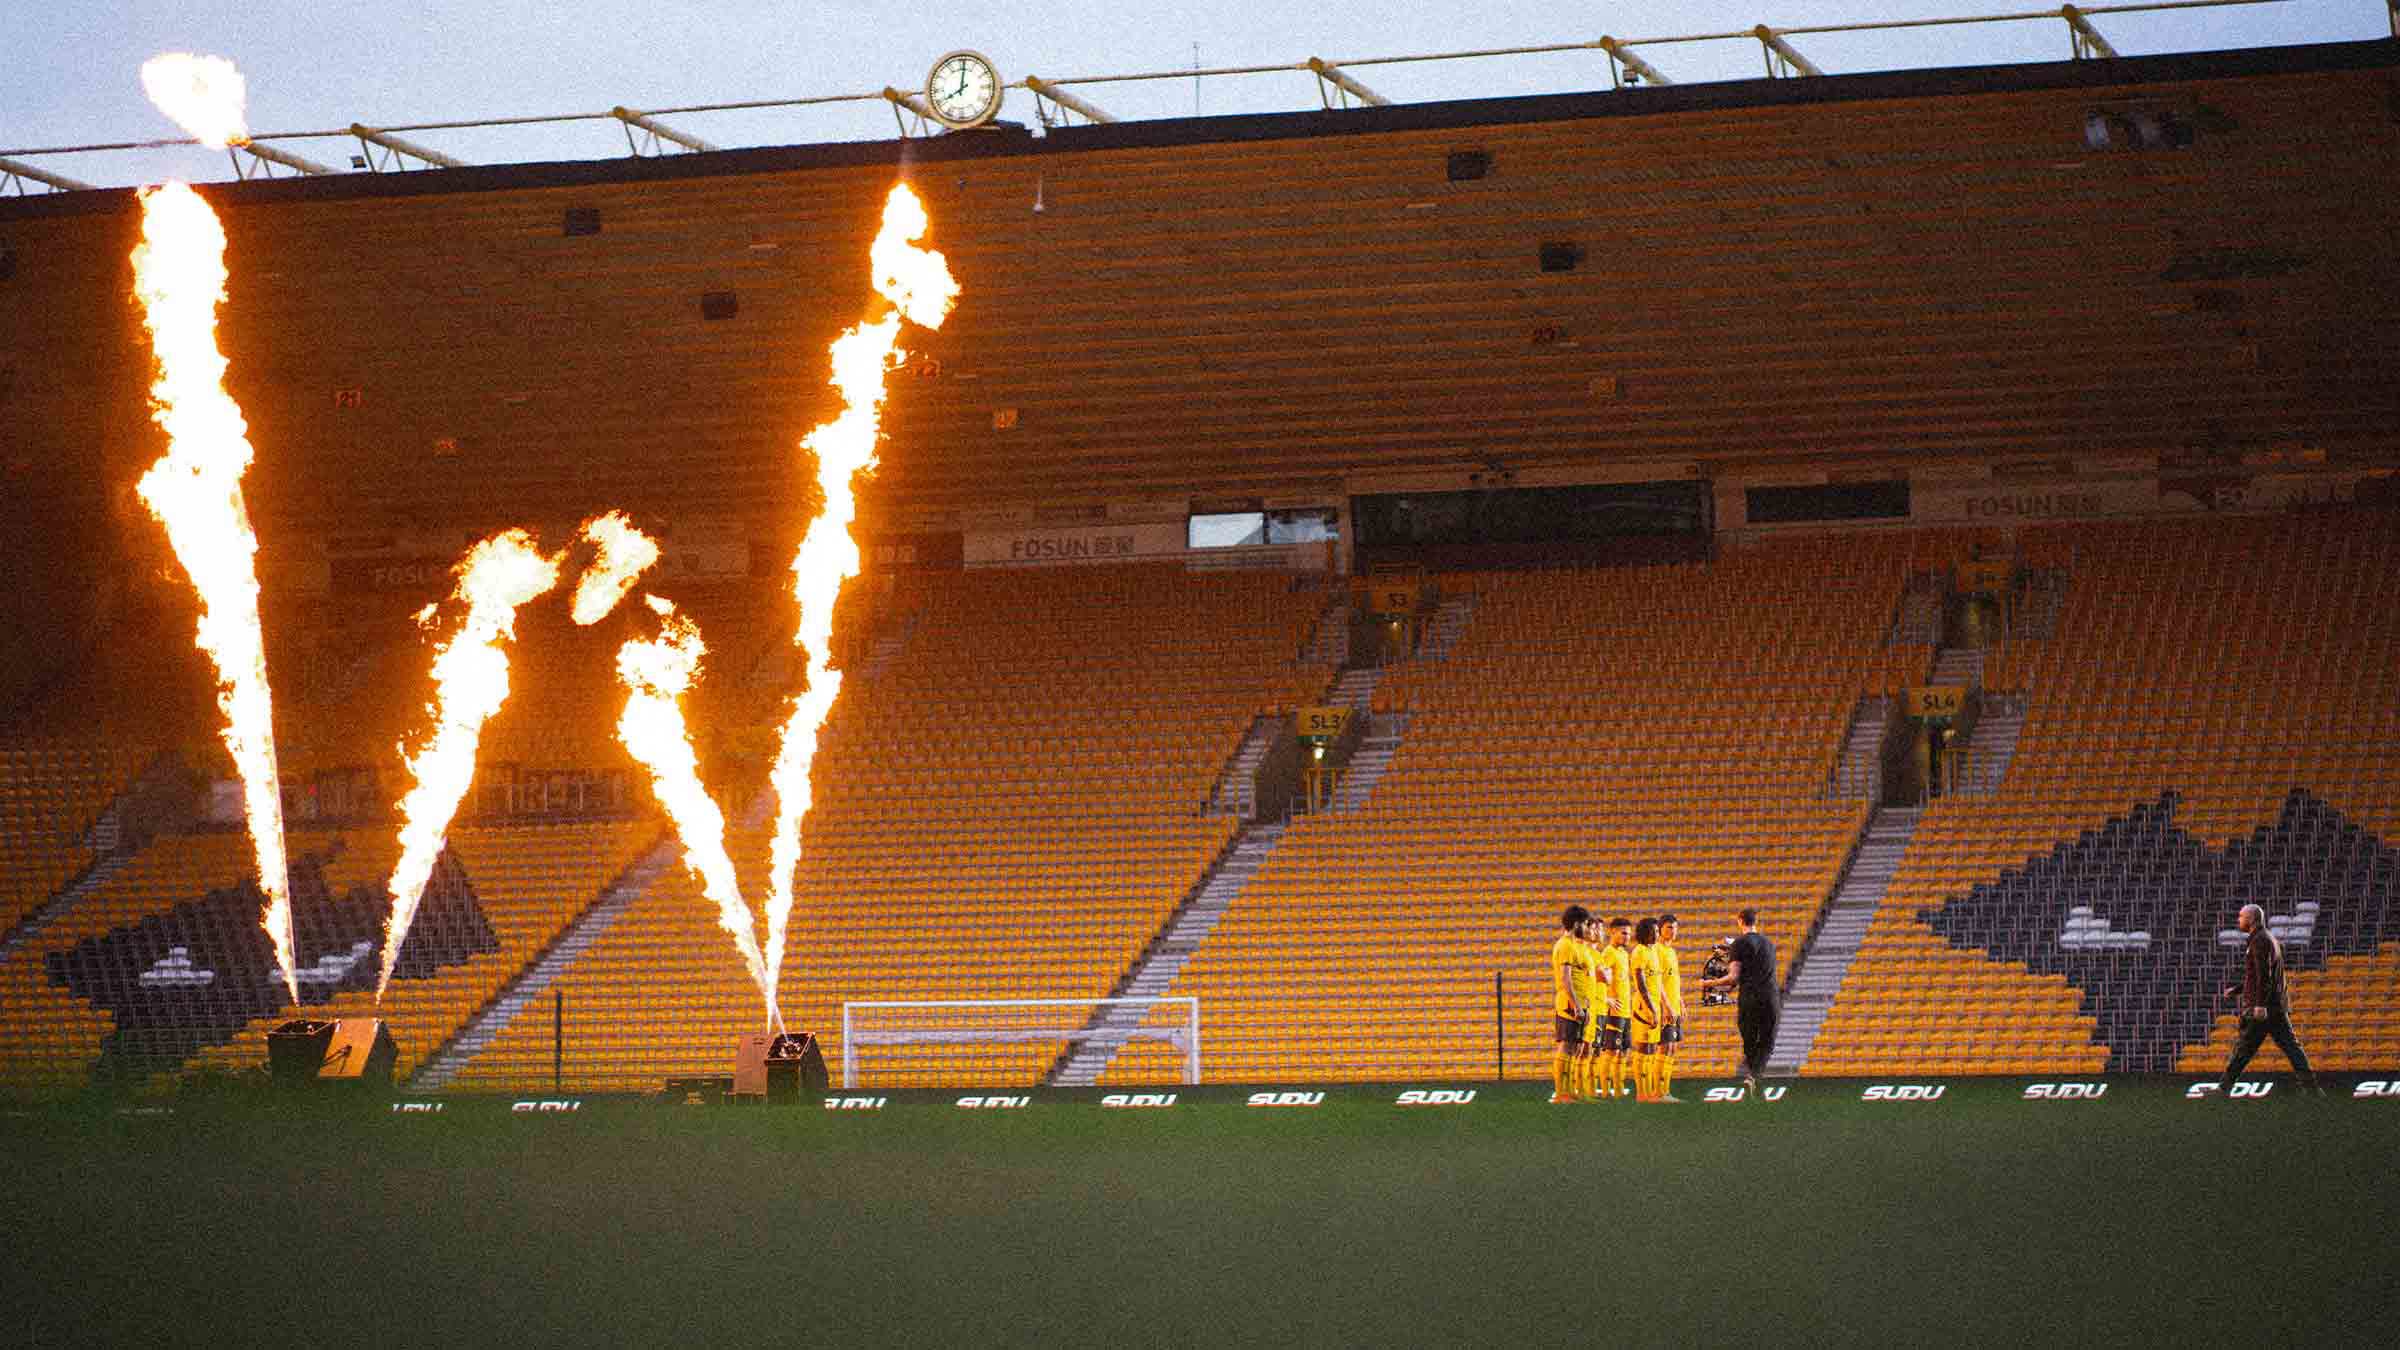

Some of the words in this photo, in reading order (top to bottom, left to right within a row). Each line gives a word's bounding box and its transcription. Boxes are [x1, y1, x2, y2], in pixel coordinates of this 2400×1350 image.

[1010, 536, 1089, 558] FOSUN
[1704, 1087, 1786, 1102] SUU
[1862, 1085, 1946, 1100] SUDU
[2024, 1083, 2107, 1098] SUDU
[2186, 1083, 2273, 1098] SDU
[2353, 1081, 2400, 1097] SU
[1101, 1094, 1177, 1107] SUDU
[1247, 1092, 1325, 1106] SUDU
[1396, 1090, 1477, 1104] SUDU
